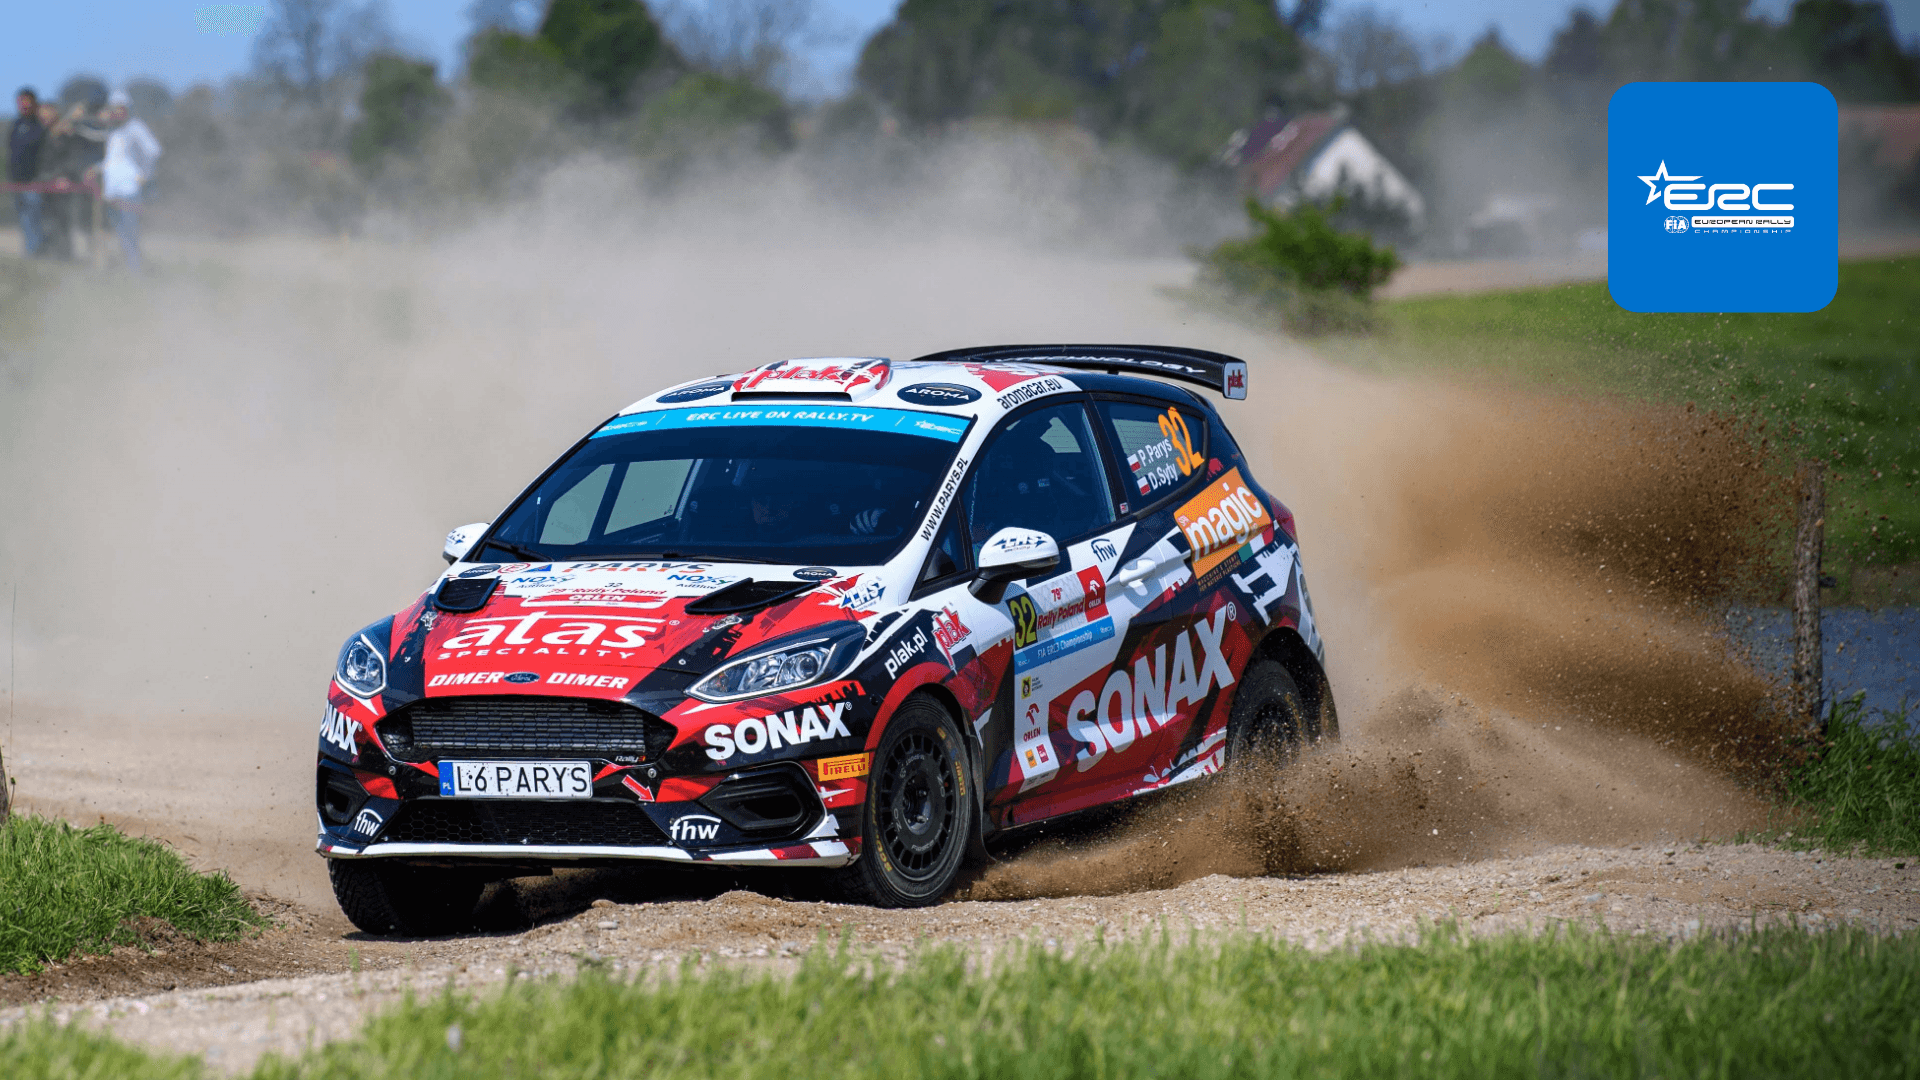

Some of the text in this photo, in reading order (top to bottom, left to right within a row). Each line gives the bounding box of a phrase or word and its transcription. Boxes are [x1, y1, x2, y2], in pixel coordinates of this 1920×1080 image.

[905, 386, 972, 402] AROMA
[996, 377, 1064, 411] aromacar.eu
[686, 411, 875, 422] ERC LIVE ON RALLY.TV
[1137, 438, 1173, 467] P.Parys
[1158, 406, 1206, 477] 32
[1148, 462, 1179, 491] D.Syty
[920, 457, 969, 542] WWW.PARYS.PL
[1186, 482, 1263, 563] magic
[1091, 538, 1118, 563] fhw
[1037, 598, 1086, 630] Rally Poland
[1088, 597, 1102, 609] ORLEN
[442, 611, 666, 650] atas
[1009, 595, 1037, 648] 32
[437, 647, 636, 660] SPECIALITY
[884, 626, 929, 680] plak.pl
[427, 672, 504, 688] DIMER
[546, 672, 629, 689] DIMER
[1023, 726, 1041, 742] ORLEN
[456, 766, 587, 793] L6 PARYS
[822, 757, 866, 776] PIRELLI
[354, 808, 383, 837] fhw
[670, 814, 722, 840] fhw
